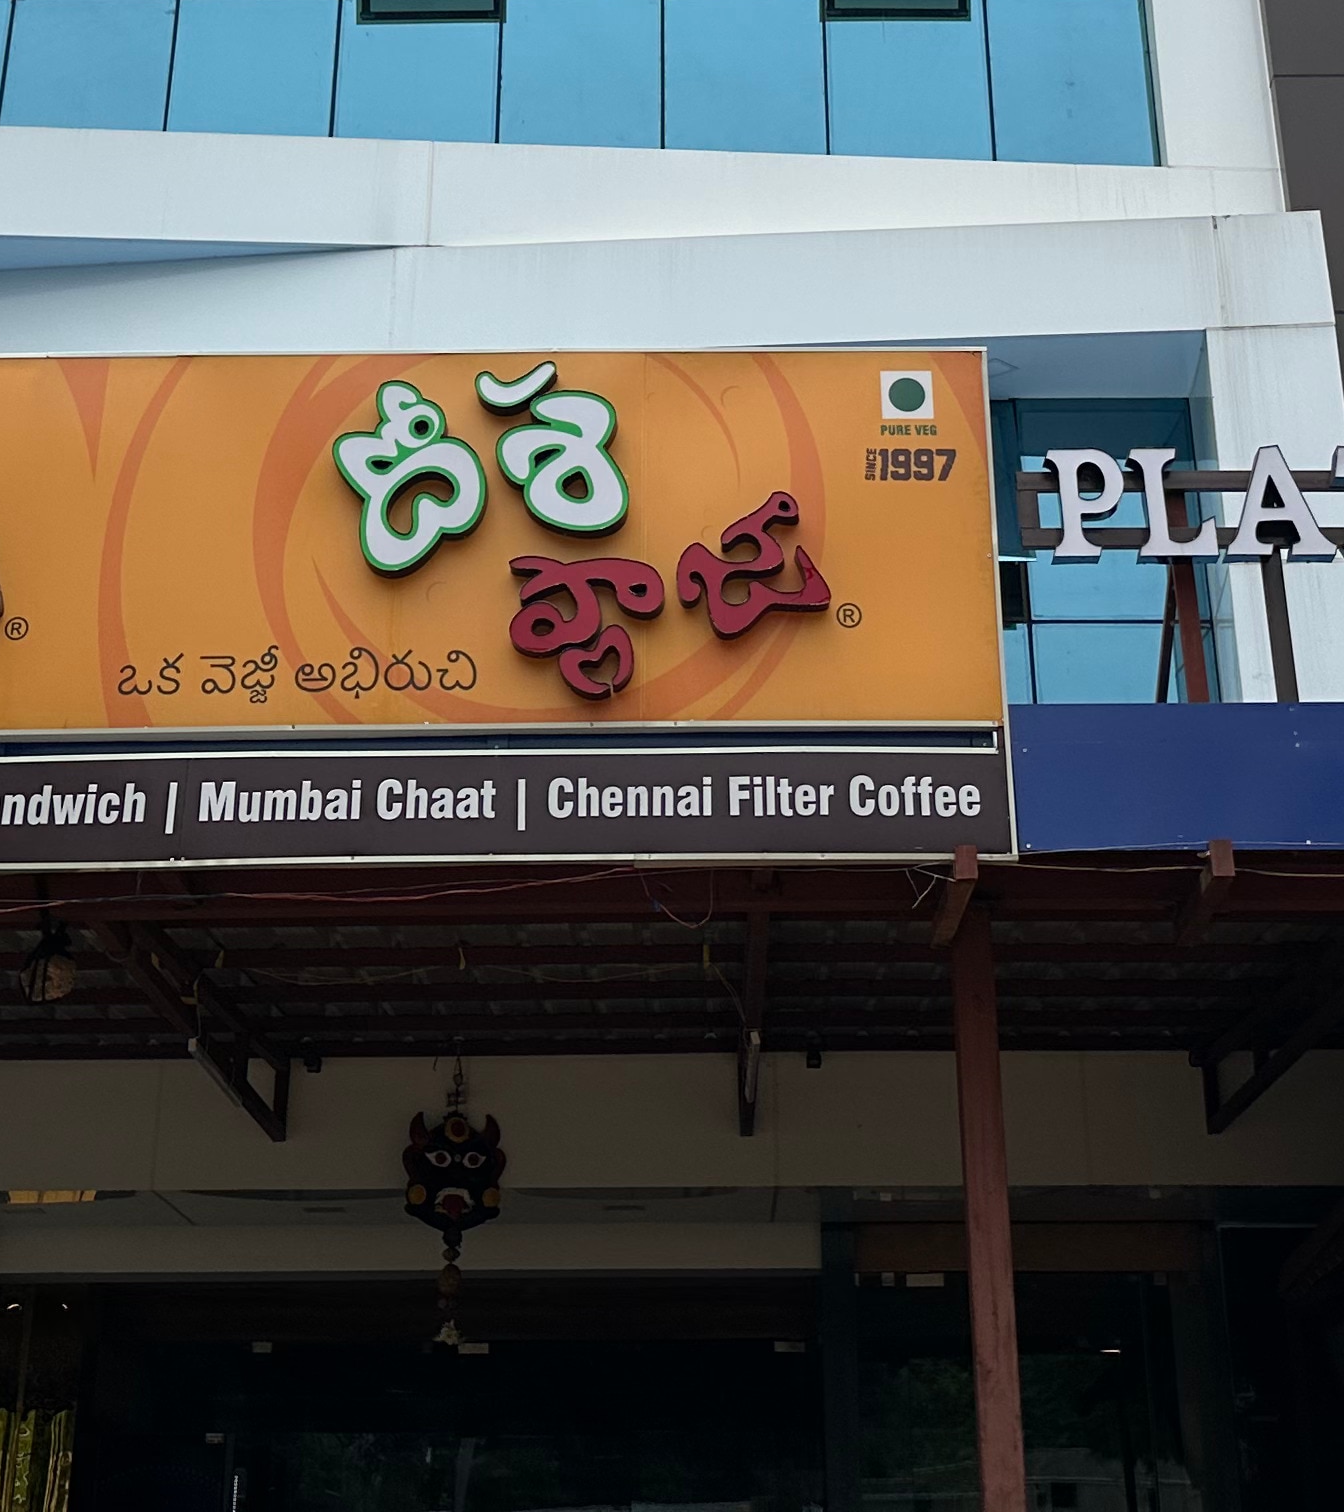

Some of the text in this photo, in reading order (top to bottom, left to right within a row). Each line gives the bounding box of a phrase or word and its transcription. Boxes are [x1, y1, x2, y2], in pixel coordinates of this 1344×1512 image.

[880, 424, 937, 436] PURE VEG
[864, 447, 877, 481] SINCE
[877, 448, 957, 481] 1997
[117, 652, 185, 696] ఒక
[294, 646, 478, 700] అభిరుచి
[198, 779, 362, 823] Mumbai
[376, 778, 497, 821] Chaat
[547, 776, 713, 819] Chennai
[728, 775, 835, 817] Filter
[849, 774, 982, 817] Coffee
